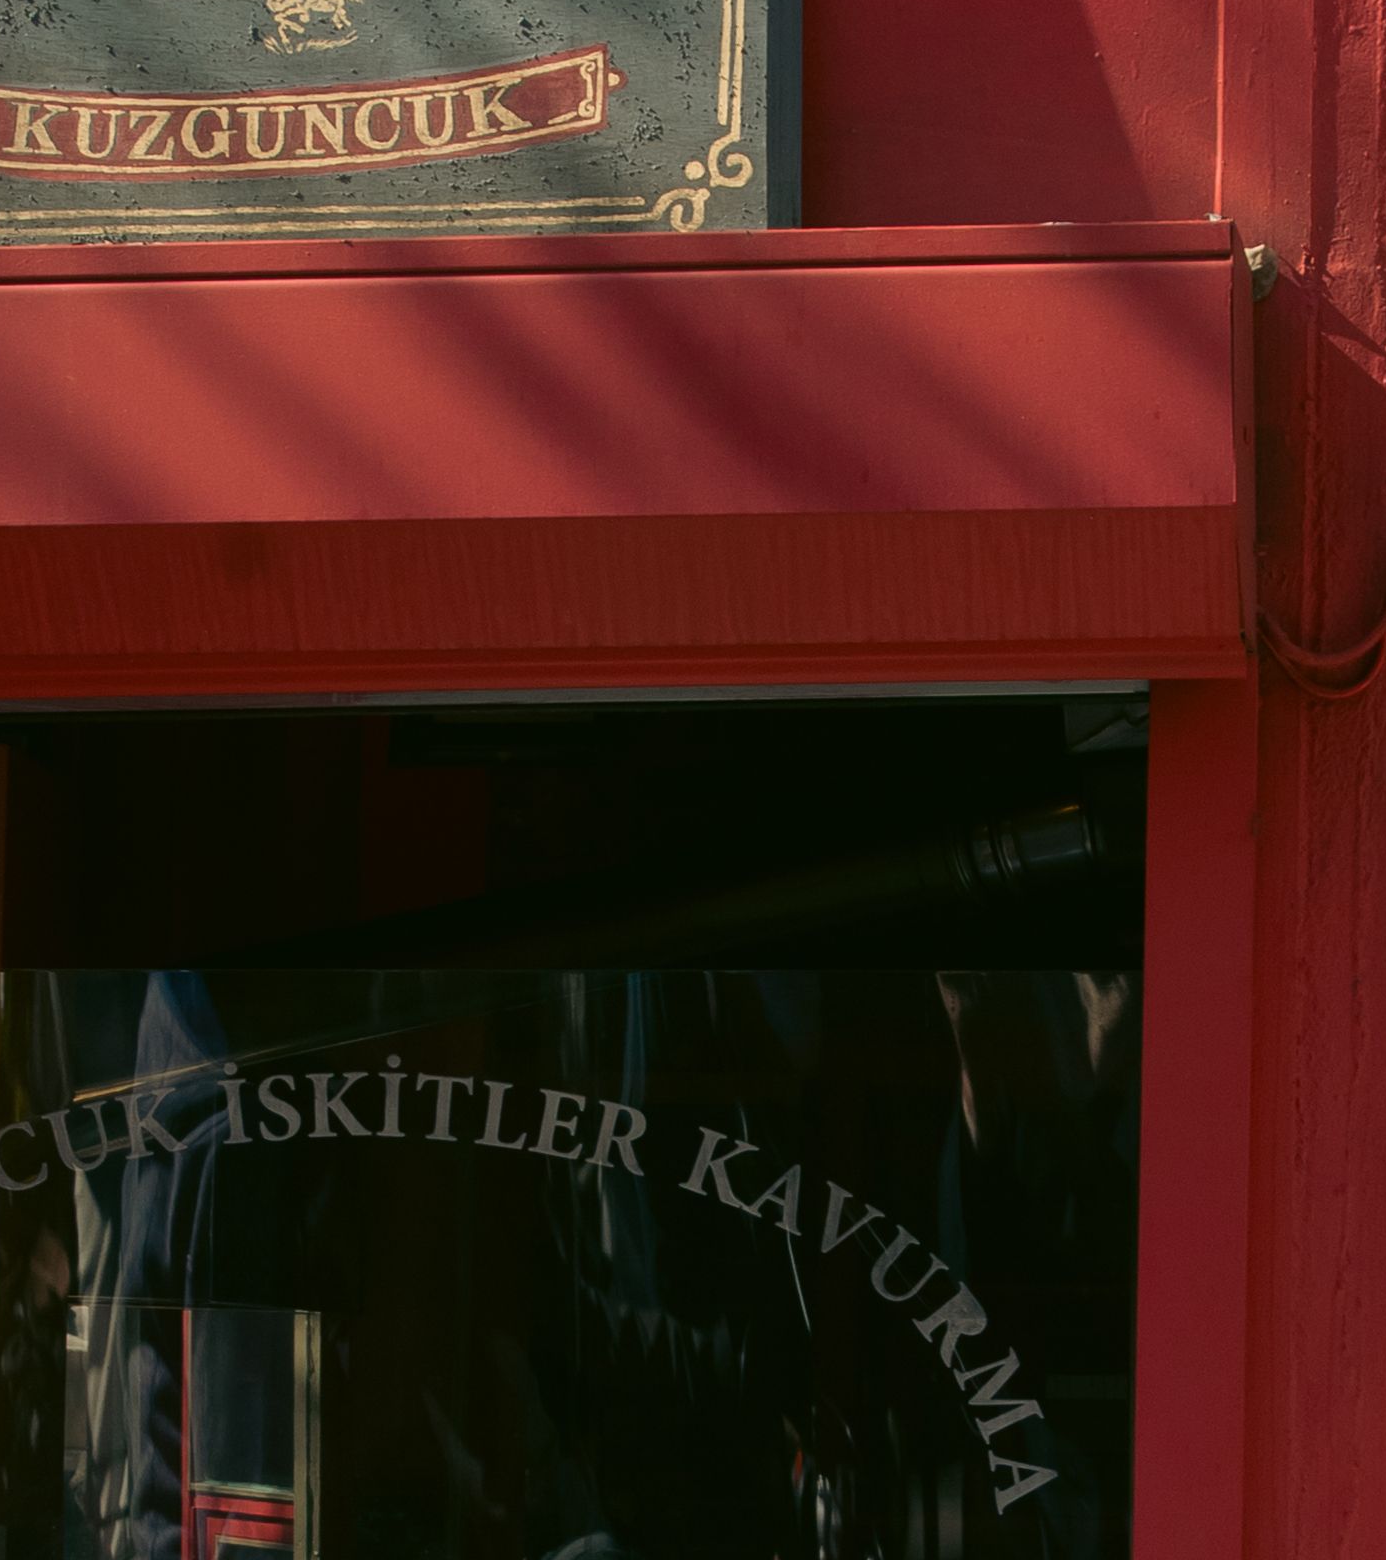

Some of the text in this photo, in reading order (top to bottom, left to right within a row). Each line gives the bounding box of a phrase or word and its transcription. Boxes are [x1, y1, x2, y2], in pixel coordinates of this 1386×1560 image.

[2, 77, 533, 162] KUZGUNCUK
[217, 1053, 648, 1177] İSKİTLER
[677, 1125, 1059, 1516] KAVURMA
